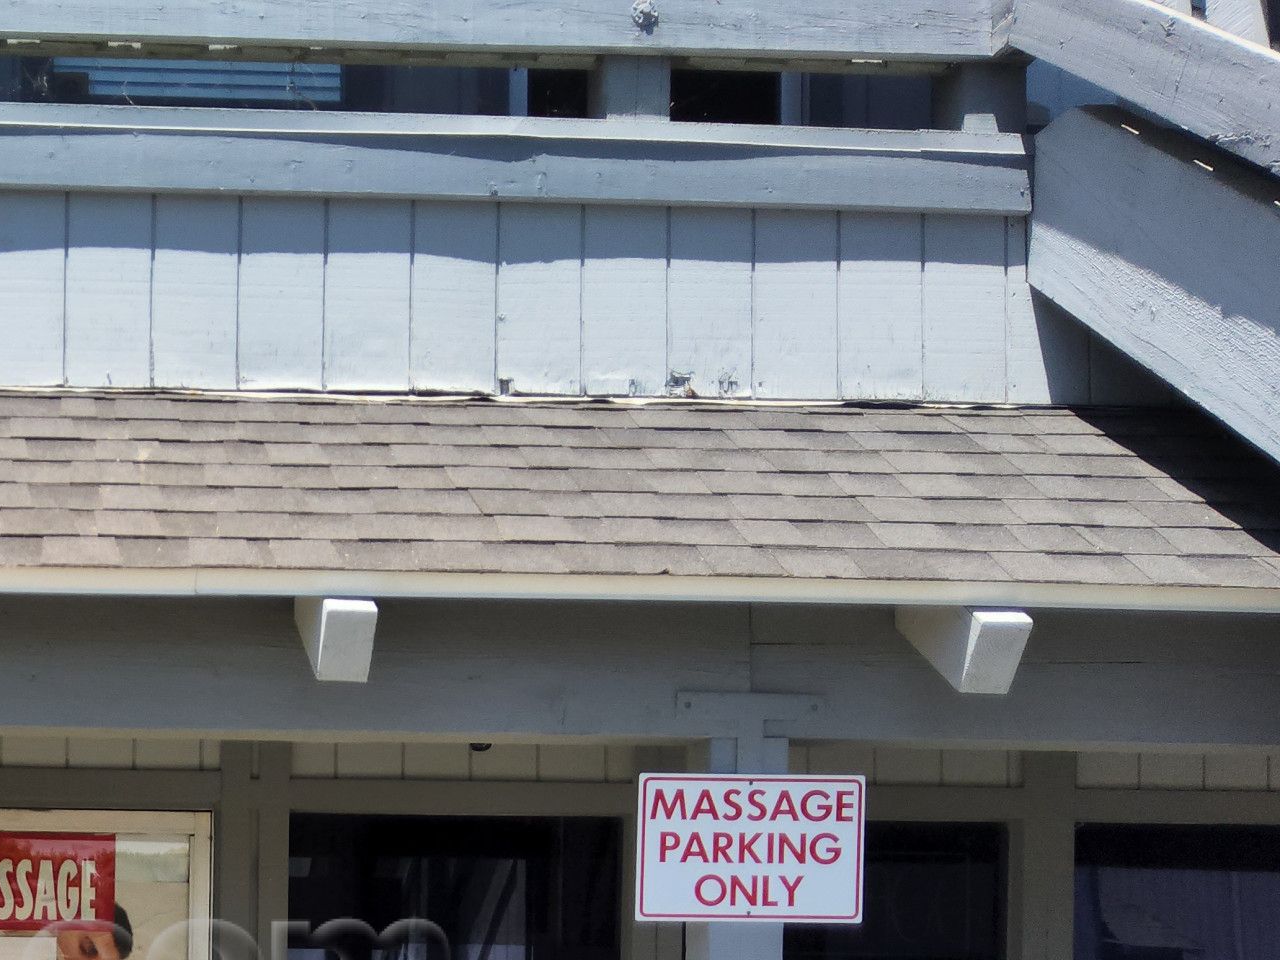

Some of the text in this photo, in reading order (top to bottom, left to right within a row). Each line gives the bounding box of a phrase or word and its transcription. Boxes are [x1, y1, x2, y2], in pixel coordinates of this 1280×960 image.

[650, 788, 855, 822] MASSAGE
[659, 831, 842, 865] PARKING
[694, 874, 805, 907] ONLY
